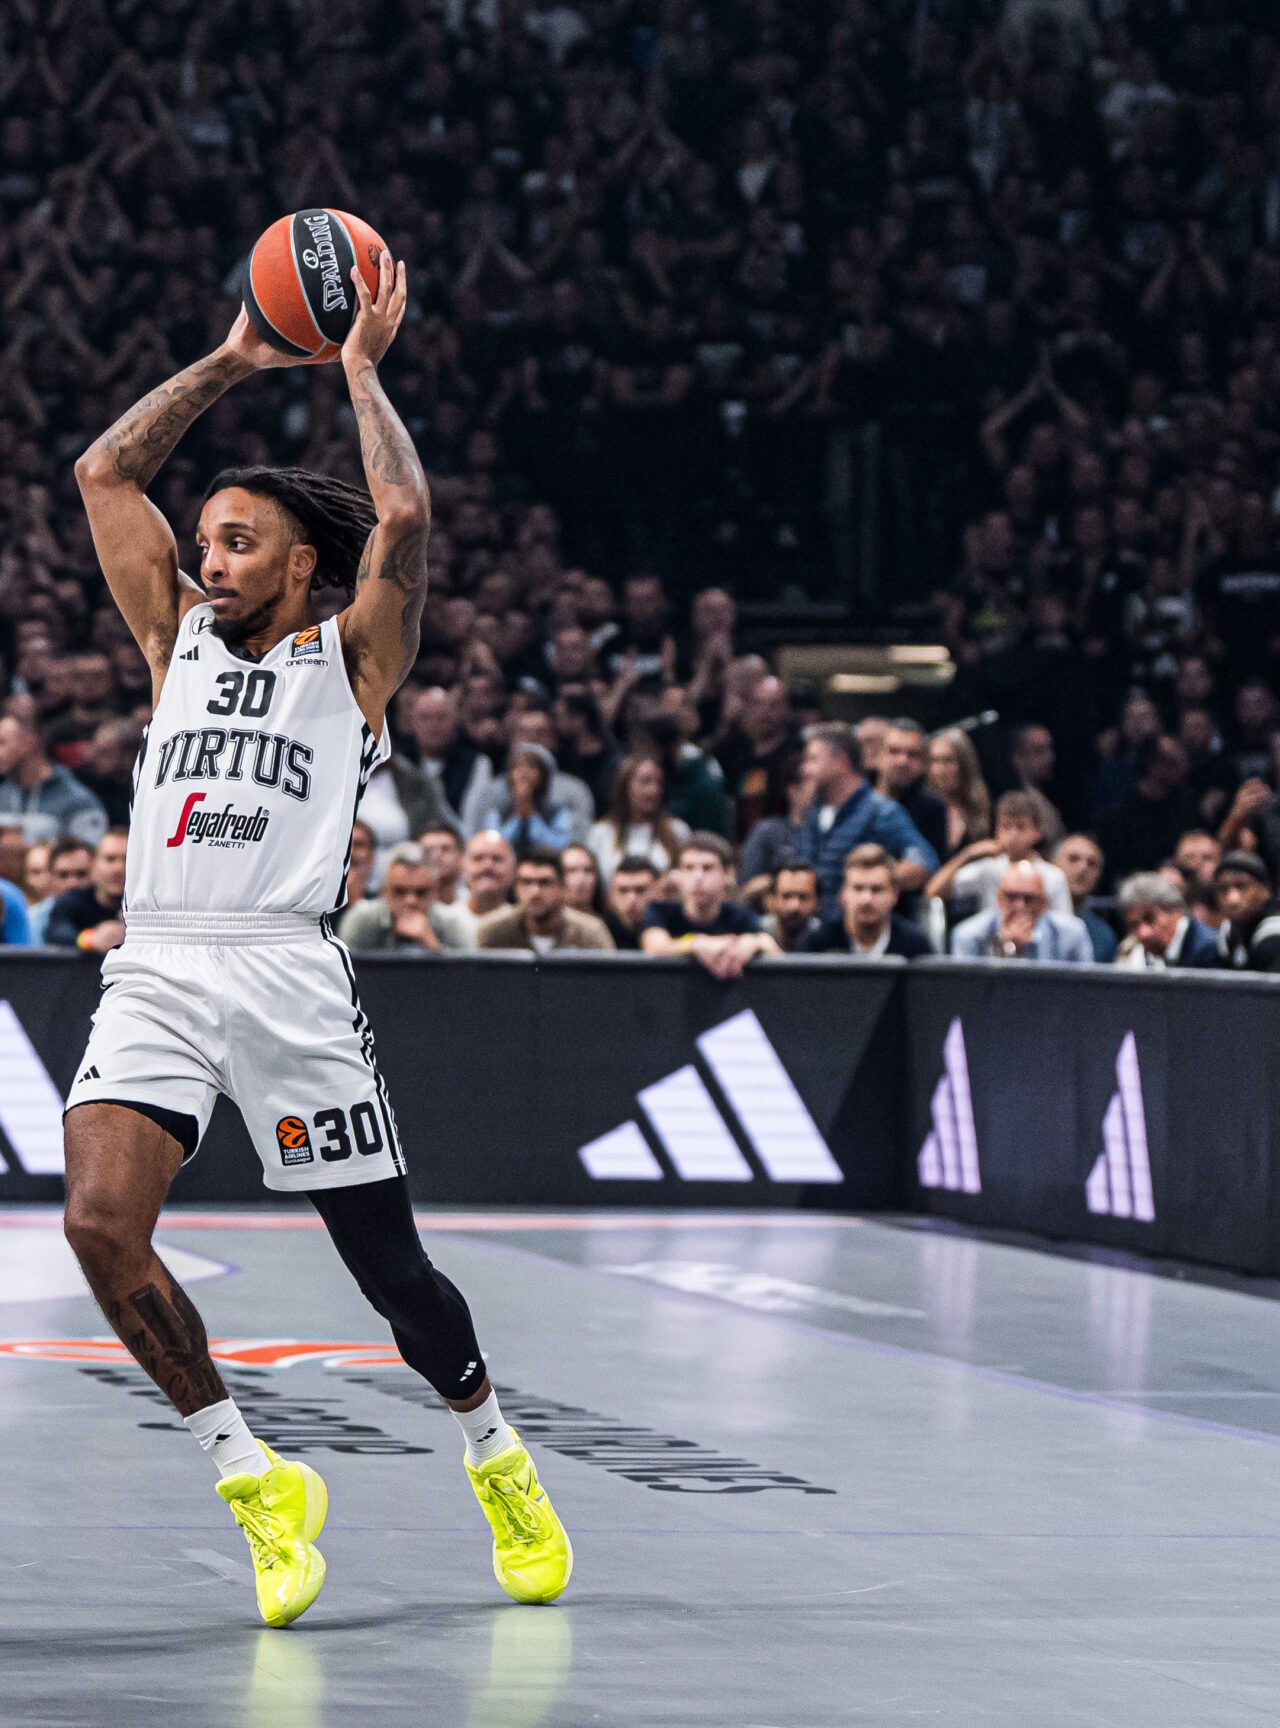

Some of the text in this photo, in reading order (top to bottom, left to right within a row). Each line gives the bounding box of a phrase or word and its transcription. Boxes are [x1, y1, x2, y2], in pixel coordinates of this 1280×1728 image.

[303, 213, 348, 312] SPALDING
[285, 658, 329, 667] oneteam
[206, 669, 277, 718] 30
[154, 727, 314, 802] VIRTUS
[166, 792, 270, 848] Segafredo
[208, 839, 245, 850] ZANETTI
[283, 1146, 309, 1154] TURKISH
[285, 1151, 310, 1159] AIRLINES
[313, 1100, 384, 1163] 30
